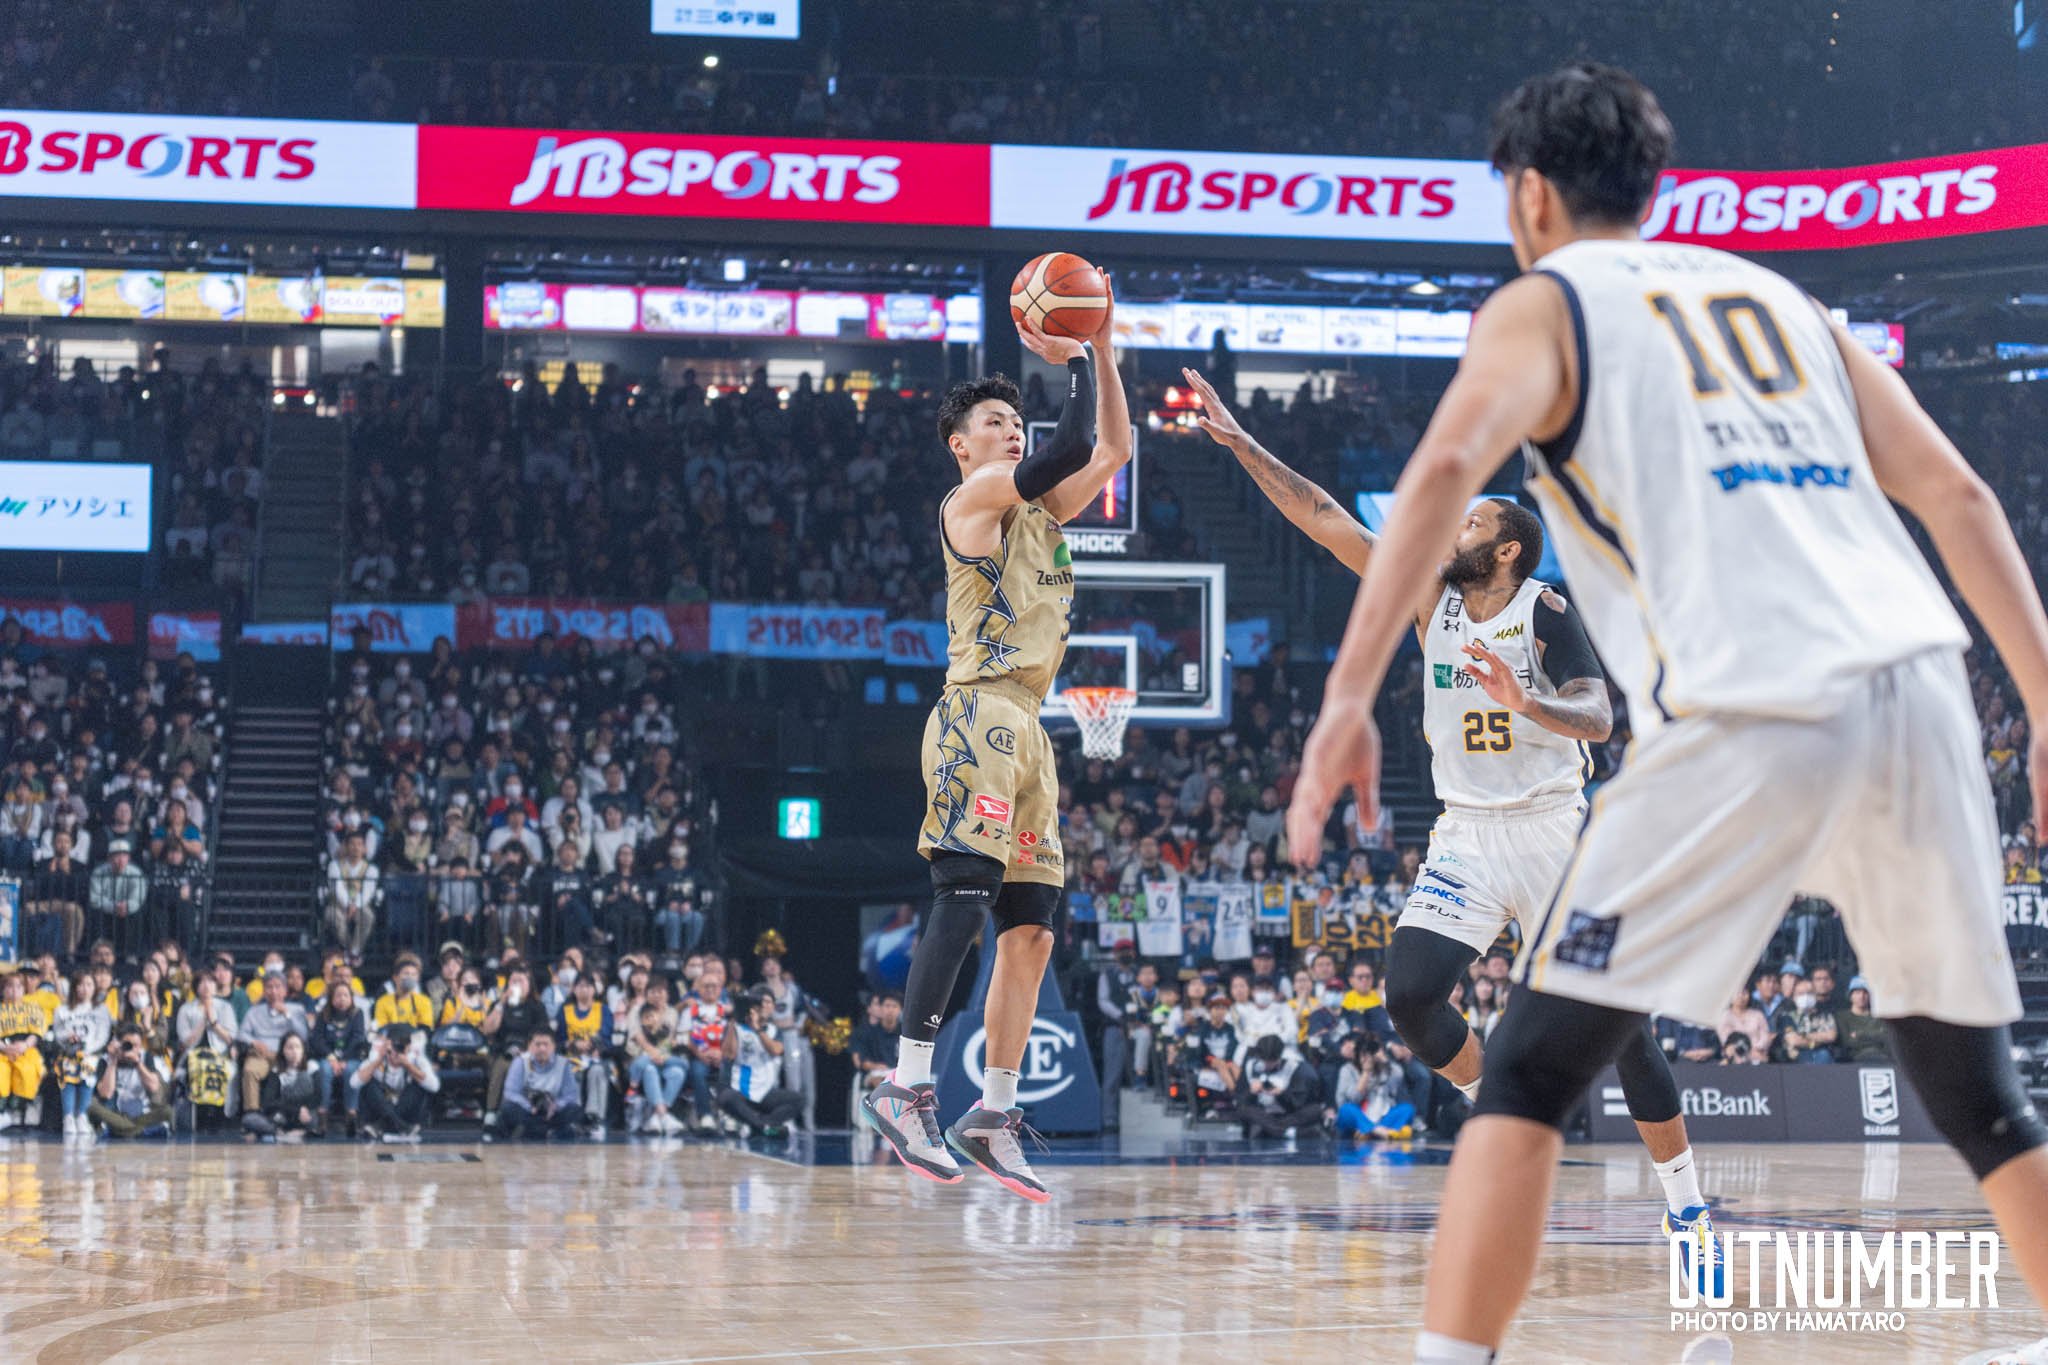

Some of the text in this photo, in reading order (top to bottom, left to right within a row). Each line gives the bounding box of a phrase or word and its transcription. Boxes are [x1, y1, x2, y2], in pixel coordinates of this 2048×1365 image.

[37, 130, 319, 181] SPORTS
[625, 147, 902, 204] SPORTS
[1197, 170, 1456, 218] SPORTS
[1740, 164, 2000, 232] SPORTS
[1645, 291, 1808, 401] 10
[1462, 709, 1514, 753] 25
[2001, 895, 2048, 928] REX
[1681, 1088, 1771, 1116] ftBank
